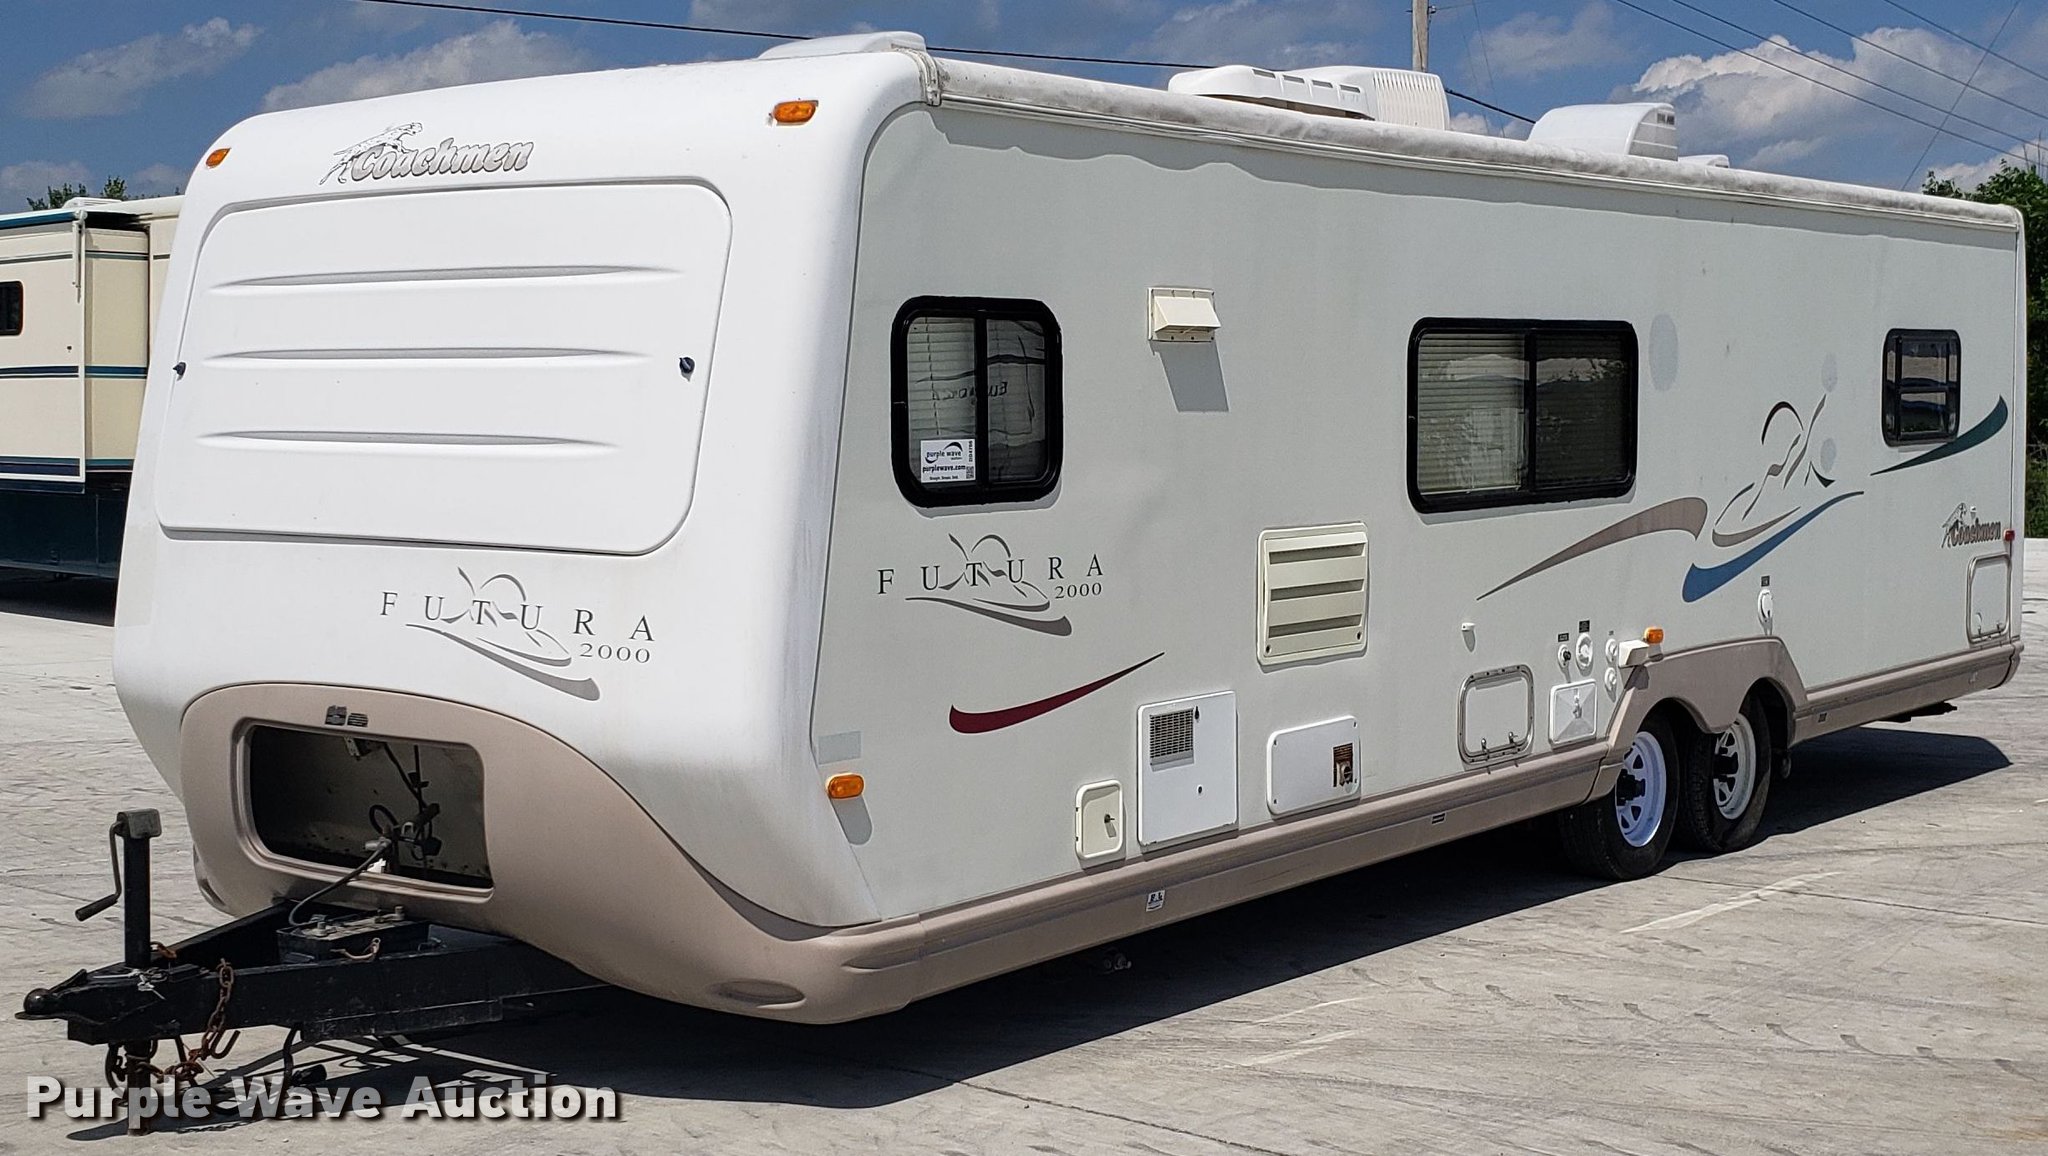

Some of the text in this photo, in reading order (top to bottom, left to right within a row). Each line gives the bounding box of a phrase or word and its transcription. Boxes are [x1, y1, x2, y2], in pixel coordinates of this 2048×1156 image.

[350, 137, 534, 182] Coachmen
[926, 450, 945, 459] purple
[877, 553, 1104, 595] FUTURA
[1054, 582, 1103, 600] 2000
[379, 591, 656, 642] FUTURA
[579, 642, 651, 664] 2000
